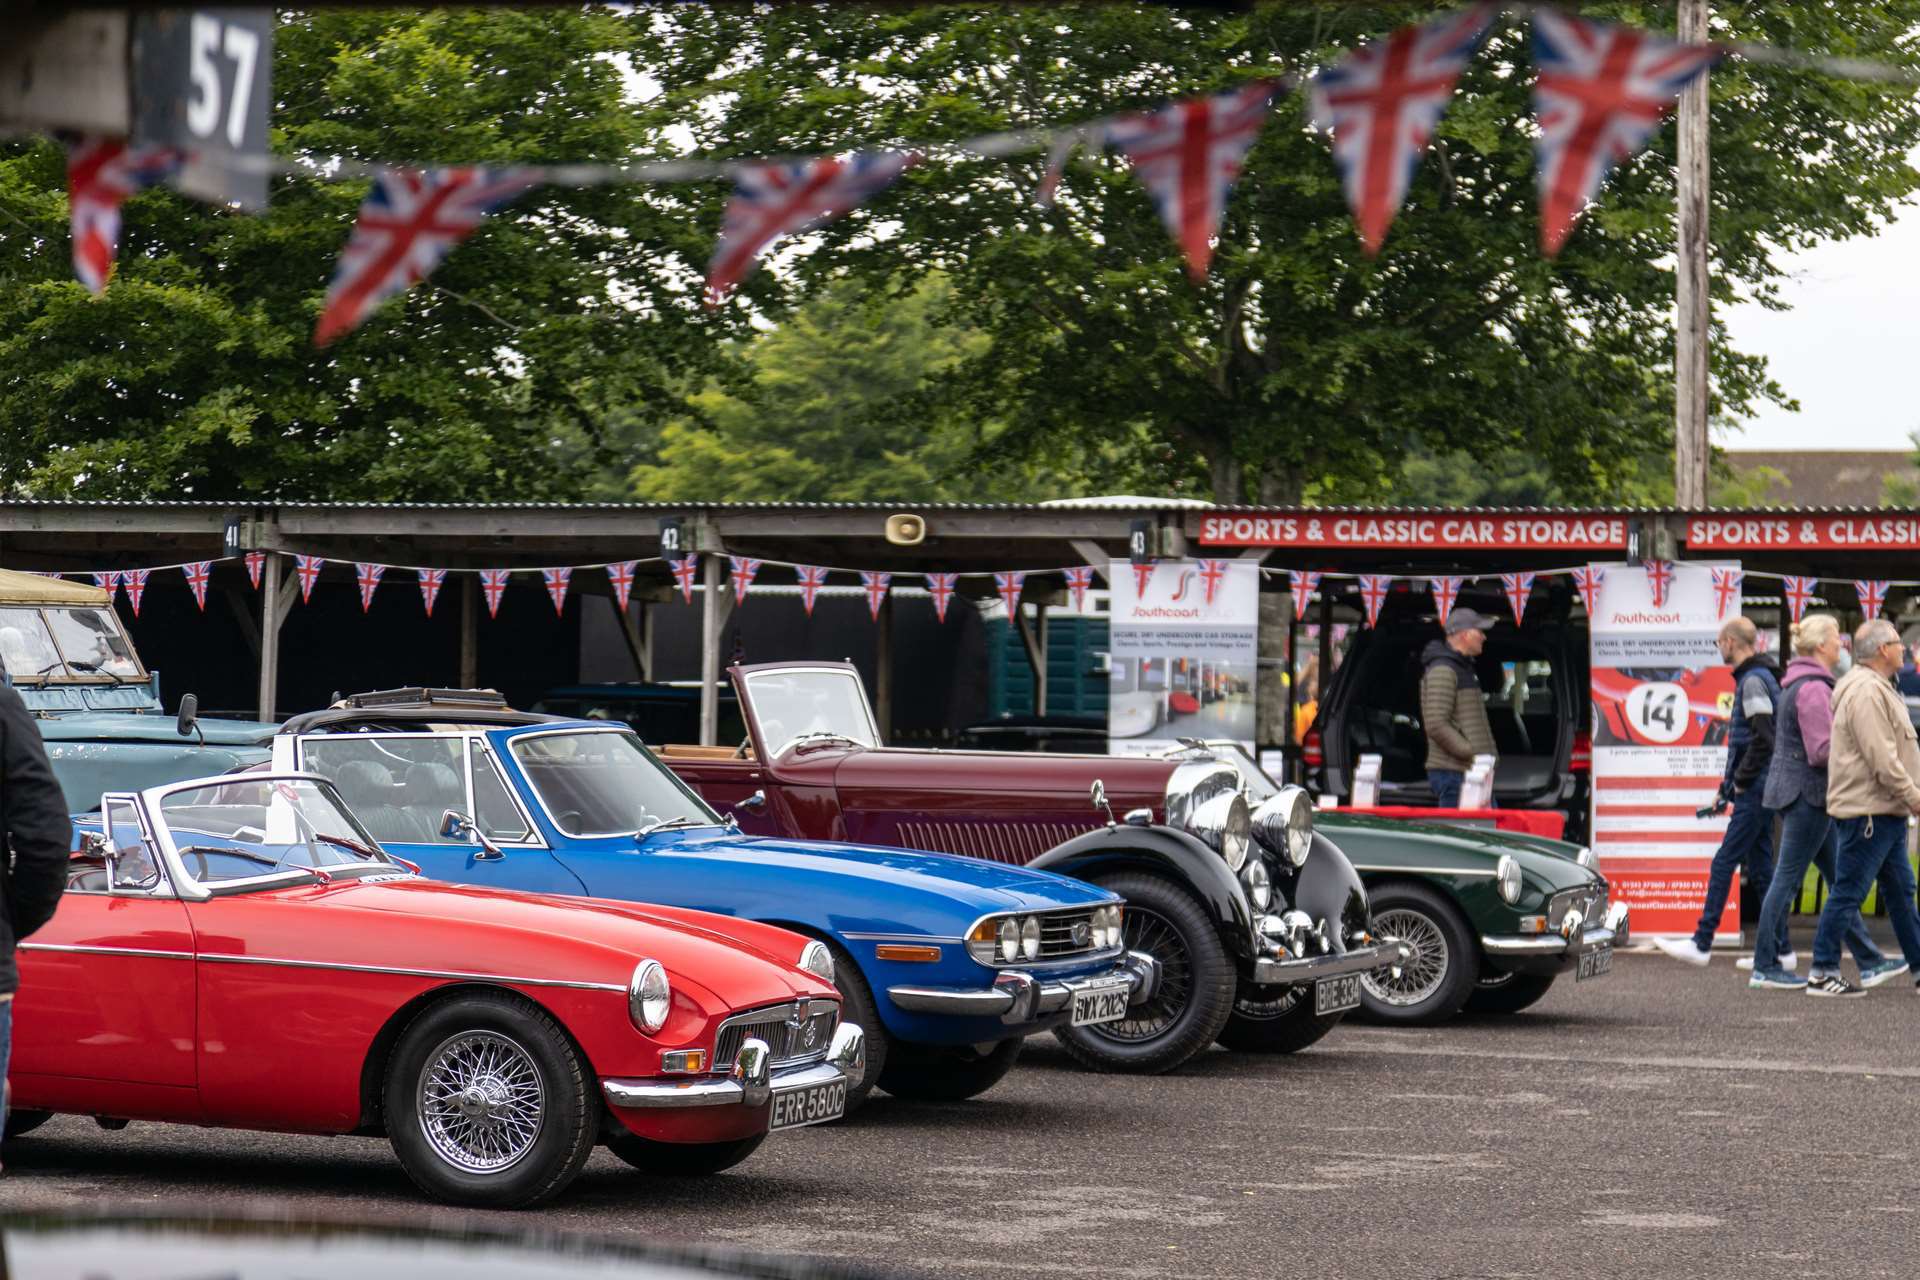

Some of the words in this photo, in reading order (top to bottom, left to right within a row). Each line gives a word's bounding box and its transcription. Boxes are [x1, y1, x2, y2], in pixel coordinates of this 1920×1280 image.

[187, 12, 259, 148] 57
[226, 526, 238, 546] 41
[662, 528, 678, 550] 42
[1131, 531, 1145, 554] 43
[1204, 518, 1298, 540] SPORTS
[1305, 519, 1324, 541] &
[1334, 520, 1435, 542] CLASSIC
[1442, 521, 1495, 543] CAR
[1502, 521, 1623, 543] STORAGE
[1692, 521, 1790, 544] SPORTS
[1799, 521, 1819, 544] &
[1829, 521, 1920, 544] CLASSI
[1642, 690, 1677, 732] 14
[1319, 980, 1339, 1010] BRE
[1340, 975, 1360, 1005] 334
[773, 1091, 805, 1126] ERR
[806, 1083, 844, 1118] 580C
